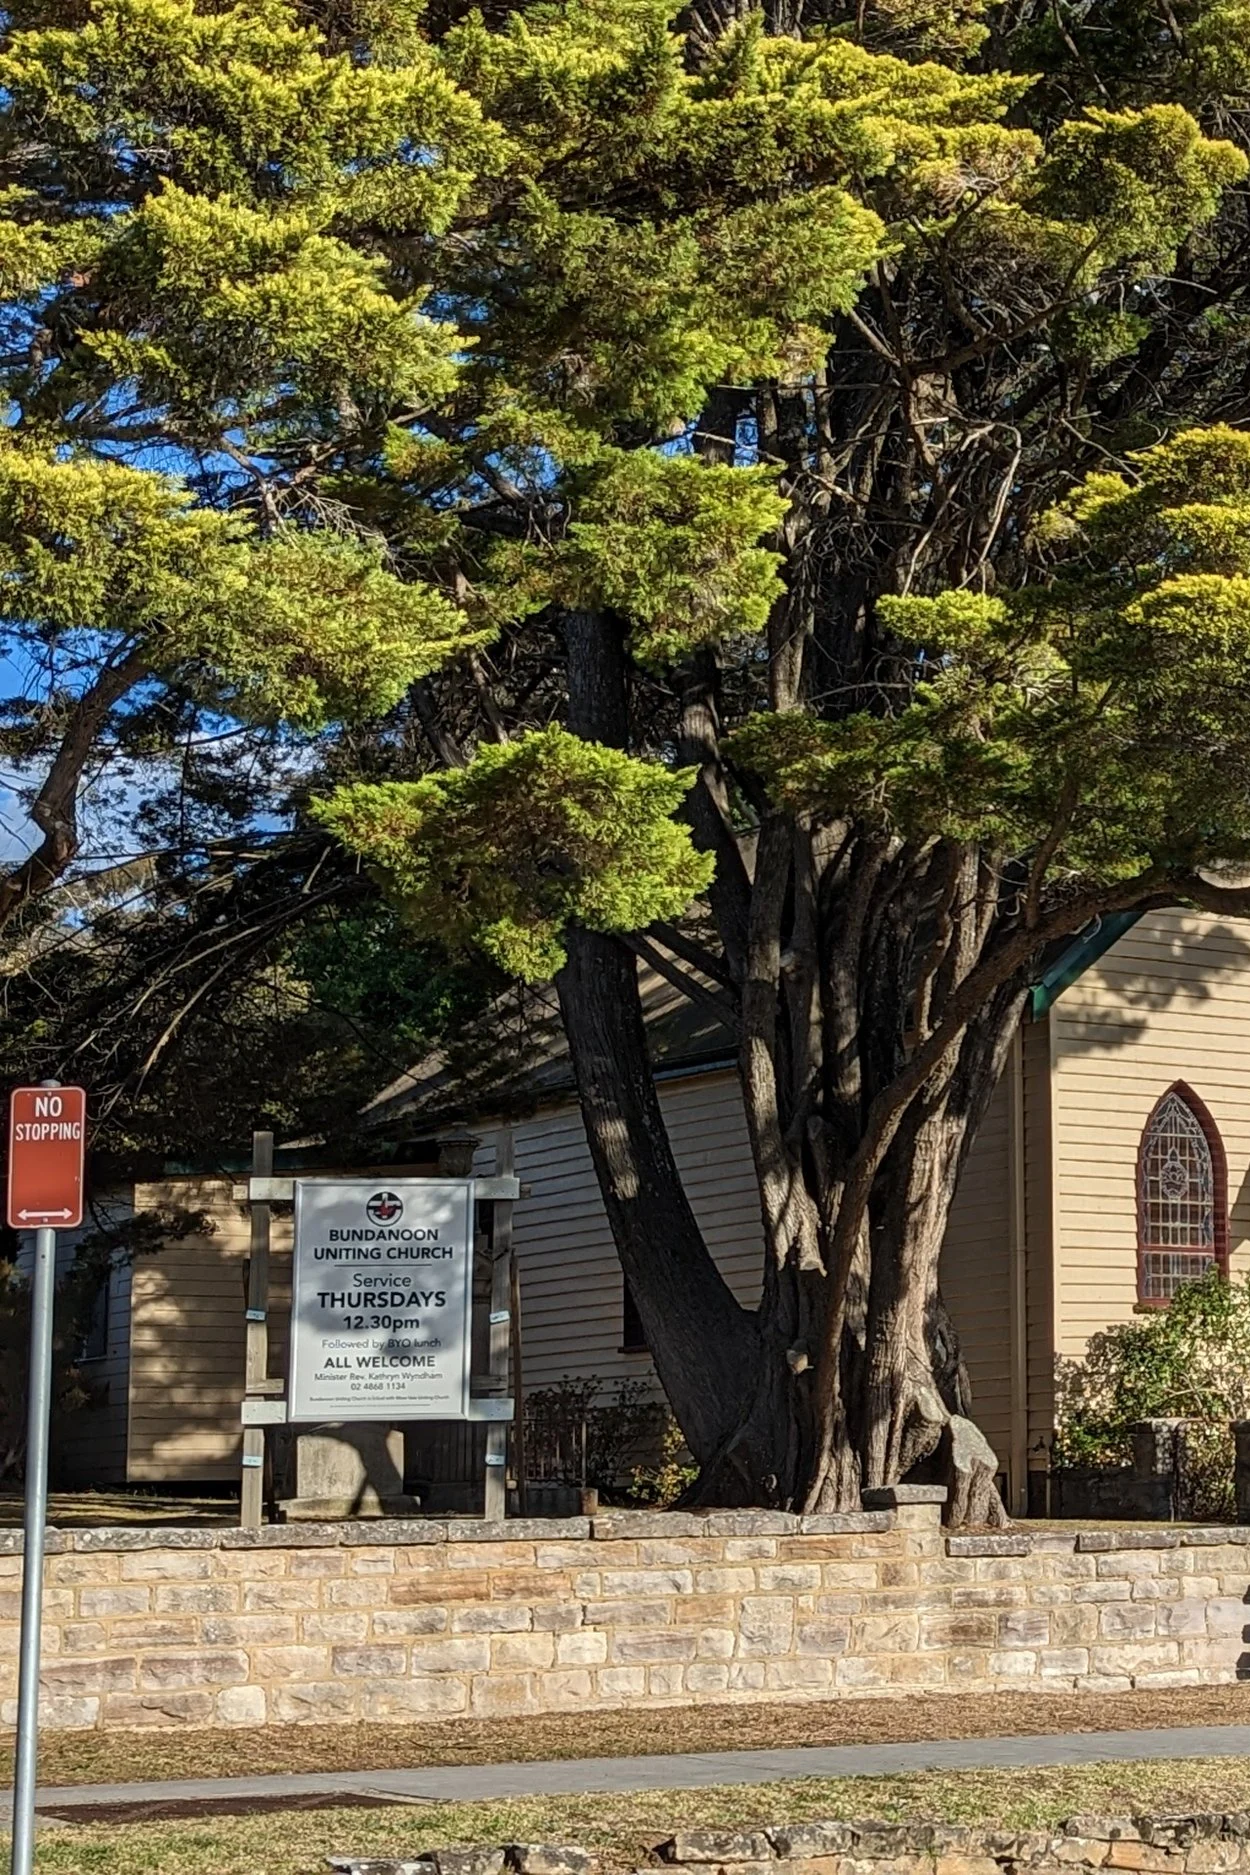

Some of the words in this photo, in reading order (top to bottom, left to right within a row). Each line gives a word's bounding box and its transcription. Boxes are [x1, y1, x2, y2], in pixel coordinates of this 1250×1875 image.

[35, 1096, 62, 1117] NO
[15, 1122, 81, 1141] STOPPING
[328, 1228, 439, 1242] BUNDANOON
[313, 1247, 382, 1261] UNITING
[386, 1246, 454, 1260] CHURCH
[352, 1272, 412, 1288] Service
[316, 1290, 447, 1309] THURSDAYS
[342, 1314, 421, 1334] 12.30pm
[321, 1339, 370, 1350] Followed
[372, 1339, 386, 1352] by
[387, 1338, 412, 1349] BYO
[413, 1337, 442, 1349] lunch
[323, 1356, 353, 1370] ALL
[356, 1355, 437, 1369] WELCOME
[313, 1373, 348, 1381] Minister
[368, 1372, 401, 1382] Kathryn
[401, 1371, 444, 1382] Wyndham
[350, 1382, 362, 1391] 02
[363, 1382, 384, 1390] 4868
[386, 1381, 406, 1390] 1134
